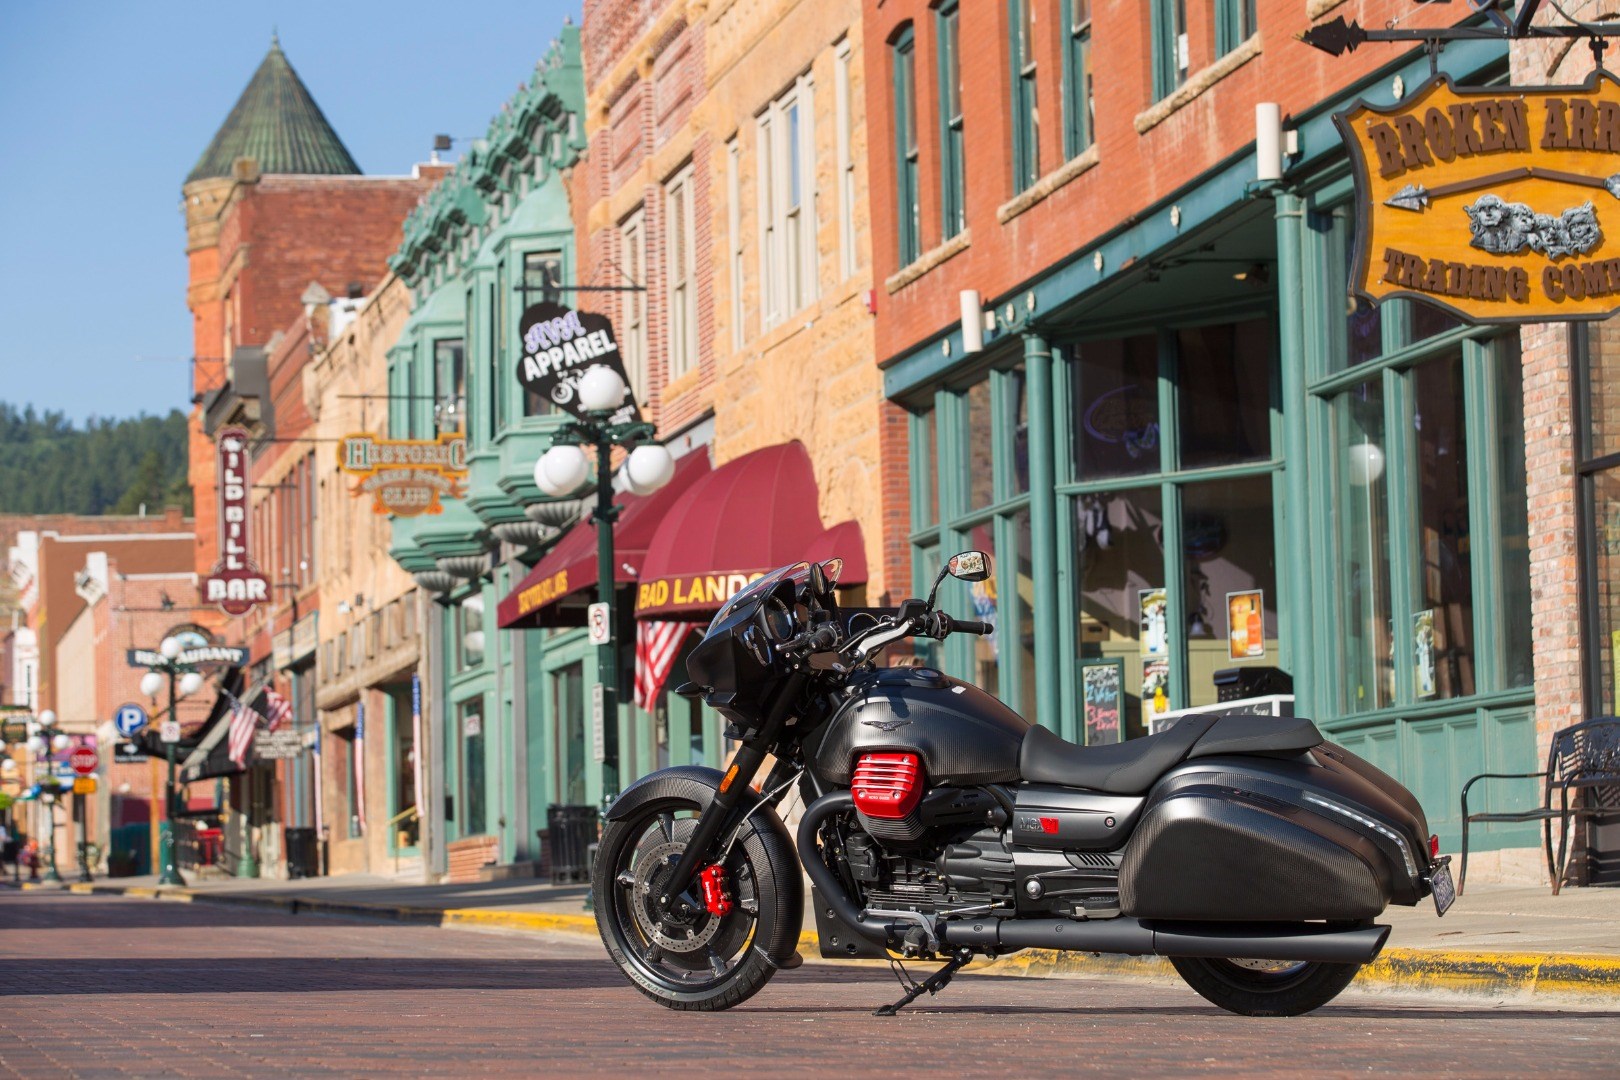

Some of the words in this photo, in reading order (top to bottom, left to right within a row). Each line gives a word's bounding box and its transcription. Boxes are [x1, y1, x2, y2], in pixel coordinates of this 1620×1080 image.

[1367, 99, 1532, 177] BROKEN
[1540, 98, 1620, 153] ARR
[1383, 247, 1529, 303] TRADING
[523, 329, 617, 382] APPAREL
[225, 506, 246, 571] BILL
[207, 578, 268, 601] BAR
[638, 580, 669, 610] BAD
[135, 647, 243, 665] RESAURANT
[121, 708, 142, 732] P
[72, 754, 97, 767] STOP
[630, 971, 664, 995] DUNLOP
